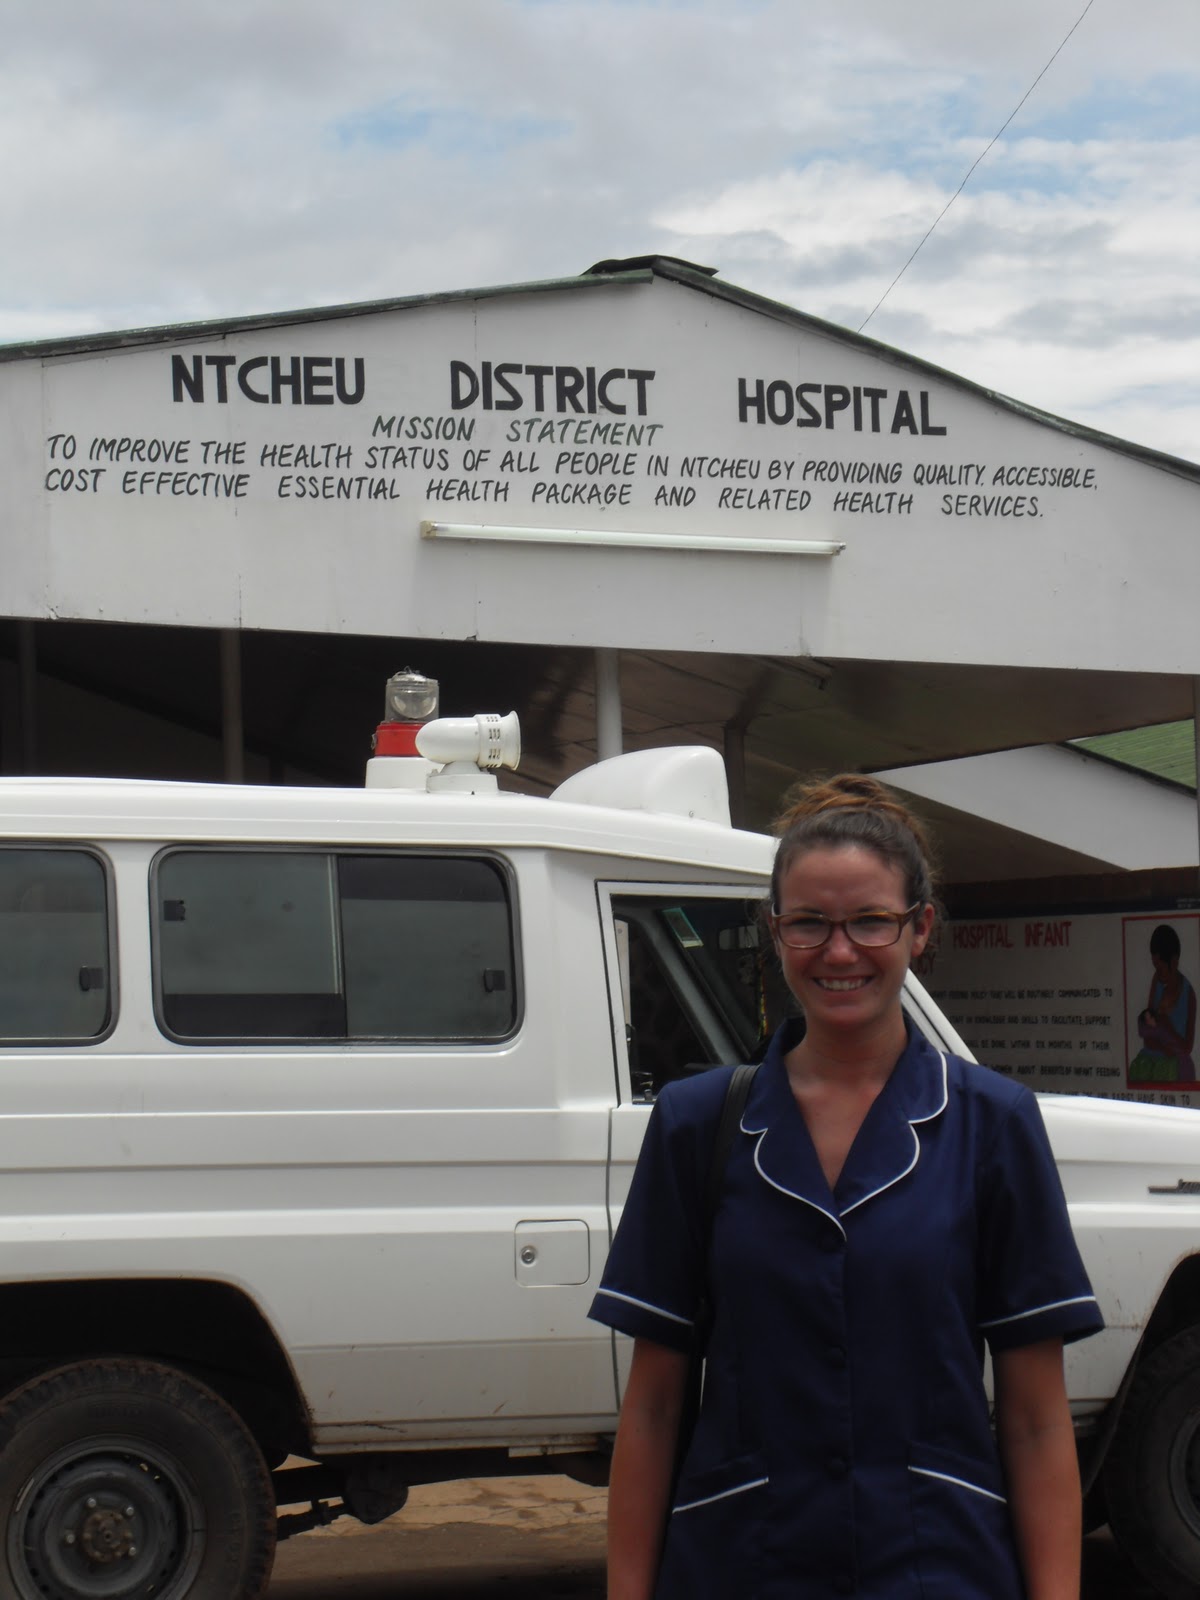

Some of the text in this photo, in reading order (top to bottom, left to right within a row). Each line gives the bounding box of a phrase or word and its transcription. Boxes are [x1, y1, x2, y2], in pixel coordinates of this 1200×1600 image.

[171, 354, 947, 436] NTCHEU DISTRICT HOSPITAL
[371, 414, 663, 446] MISSION STATEMENT
[46, 433, 77, 461] TO
[88, 437, 191, 464] IMPROVE
[200, 440, 247, 465] THE
[259, 442, 353, 469] HEALTH
[364, 445, 450, 472] STATUS
[462, 448, 492, 472] OF
[499, 449, 540, 473] ALL
[554, 451, 638, 476] PEOPLE
[646, 454, 670, 477] IN
[680, 456, 761, 480] NTCHEU
[767, 459, 796, 481] BY
[802, 460, 903, 485] PROVIDING
[43, 467, 1044, 518] COST EFFECTIVE ESSENTIAL HEALTH PACKAGE AND RELATED HEALTH SERVICES.
[952, 923, 1014, 949] HOSPITAL
[1024, 920, 1072, 948] INFANT
[1104, 988, 1113, 997] TO
[1181, 1094, 1190, 1106] TO
